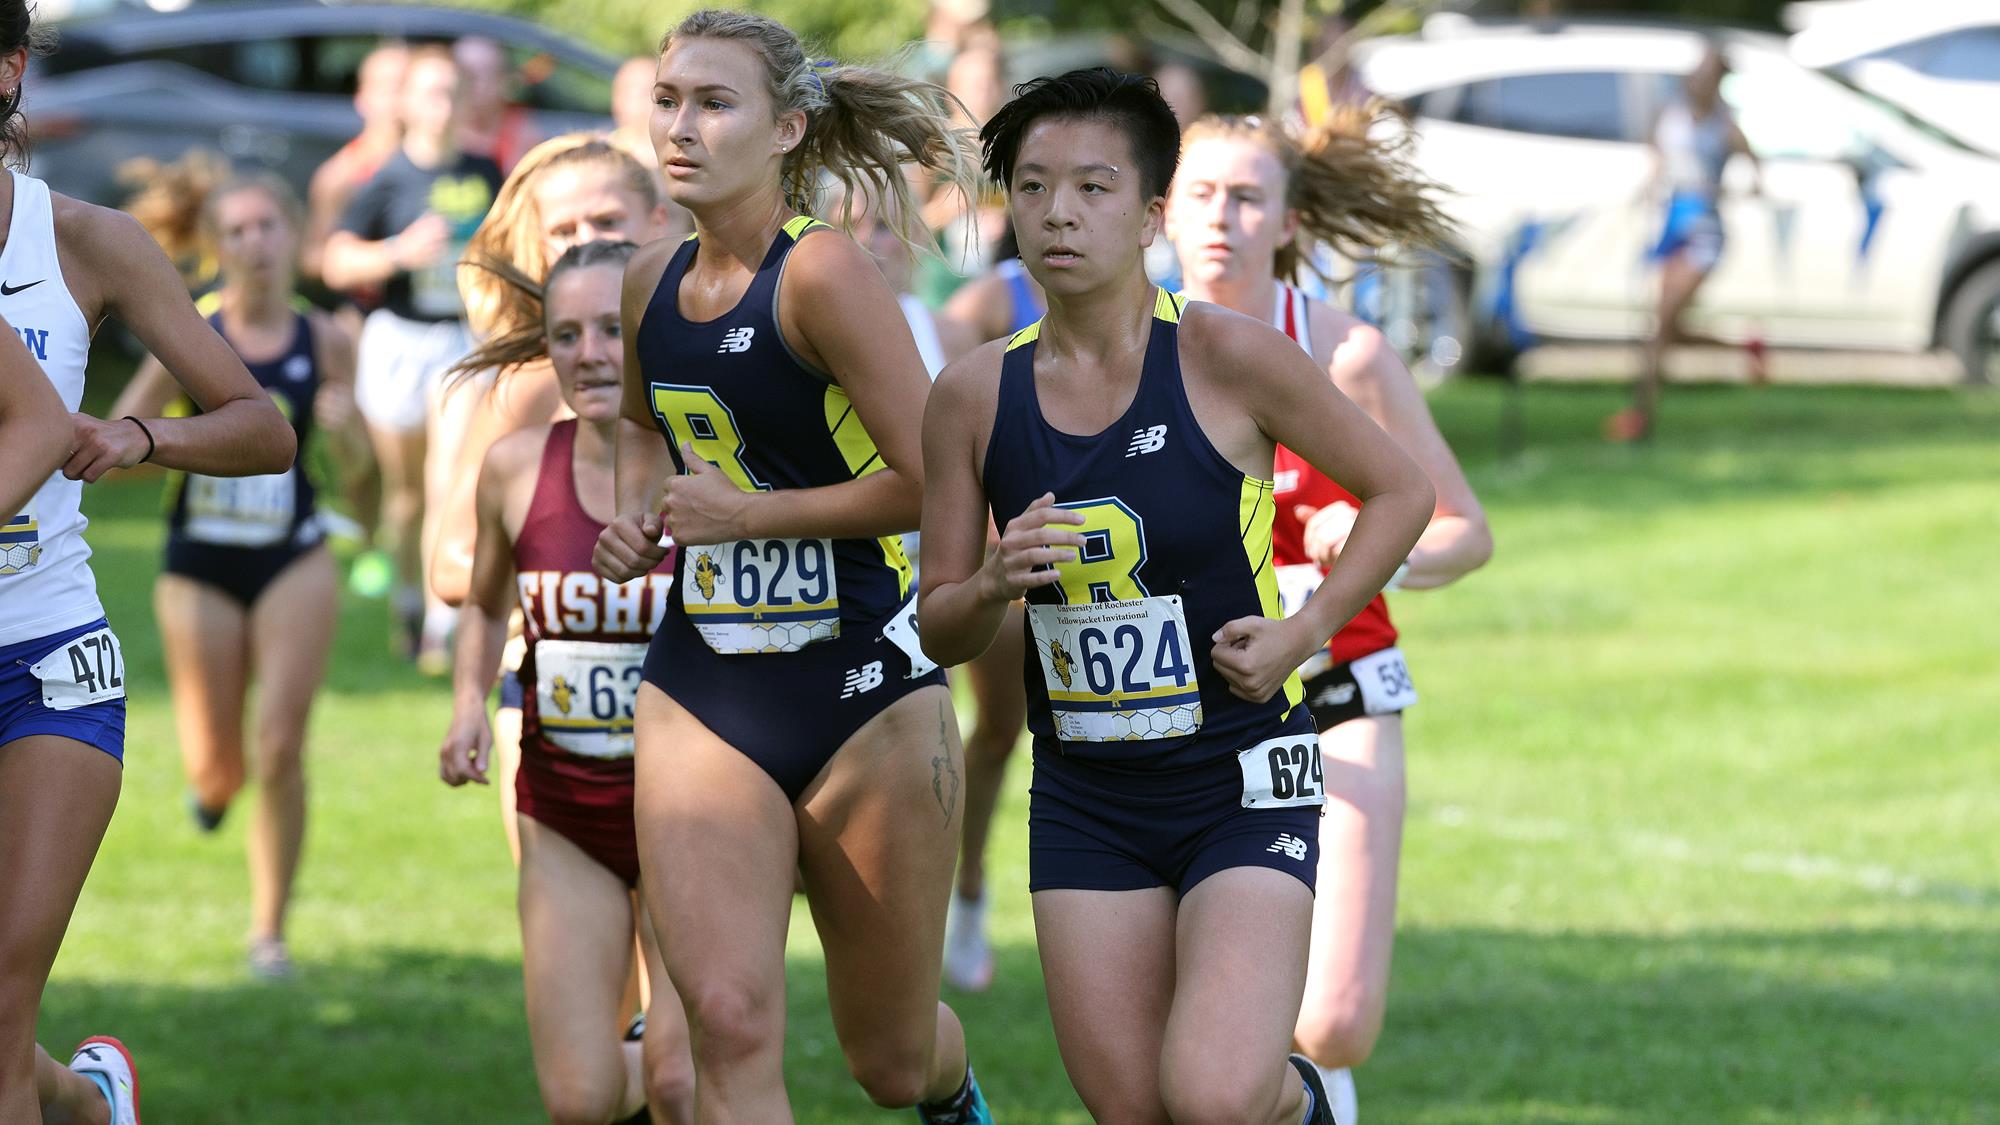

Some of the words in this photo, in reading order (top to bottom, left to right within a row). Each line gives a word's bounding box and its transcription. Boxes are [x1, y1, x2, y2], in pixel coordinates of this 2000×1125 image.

[12, 327, 49, 361] N
[651, 382, 773, 492] R
[733, 538, 829, 607] 629
[1043, 496, 1150, 605] R
[1056, 603, 1093, 613] University
[1095, 602, 1103, 610] of
[1104, 600, 1144, 609] Rochester
[1056, 615, 1101, 625] Yellowjacket
[1102, 611, 1149, 622] Invitational
[68, 634, 122, 693] 472
[1079, 620, 1190, 696] 624
[1267, 743, 1325, 800] 624
